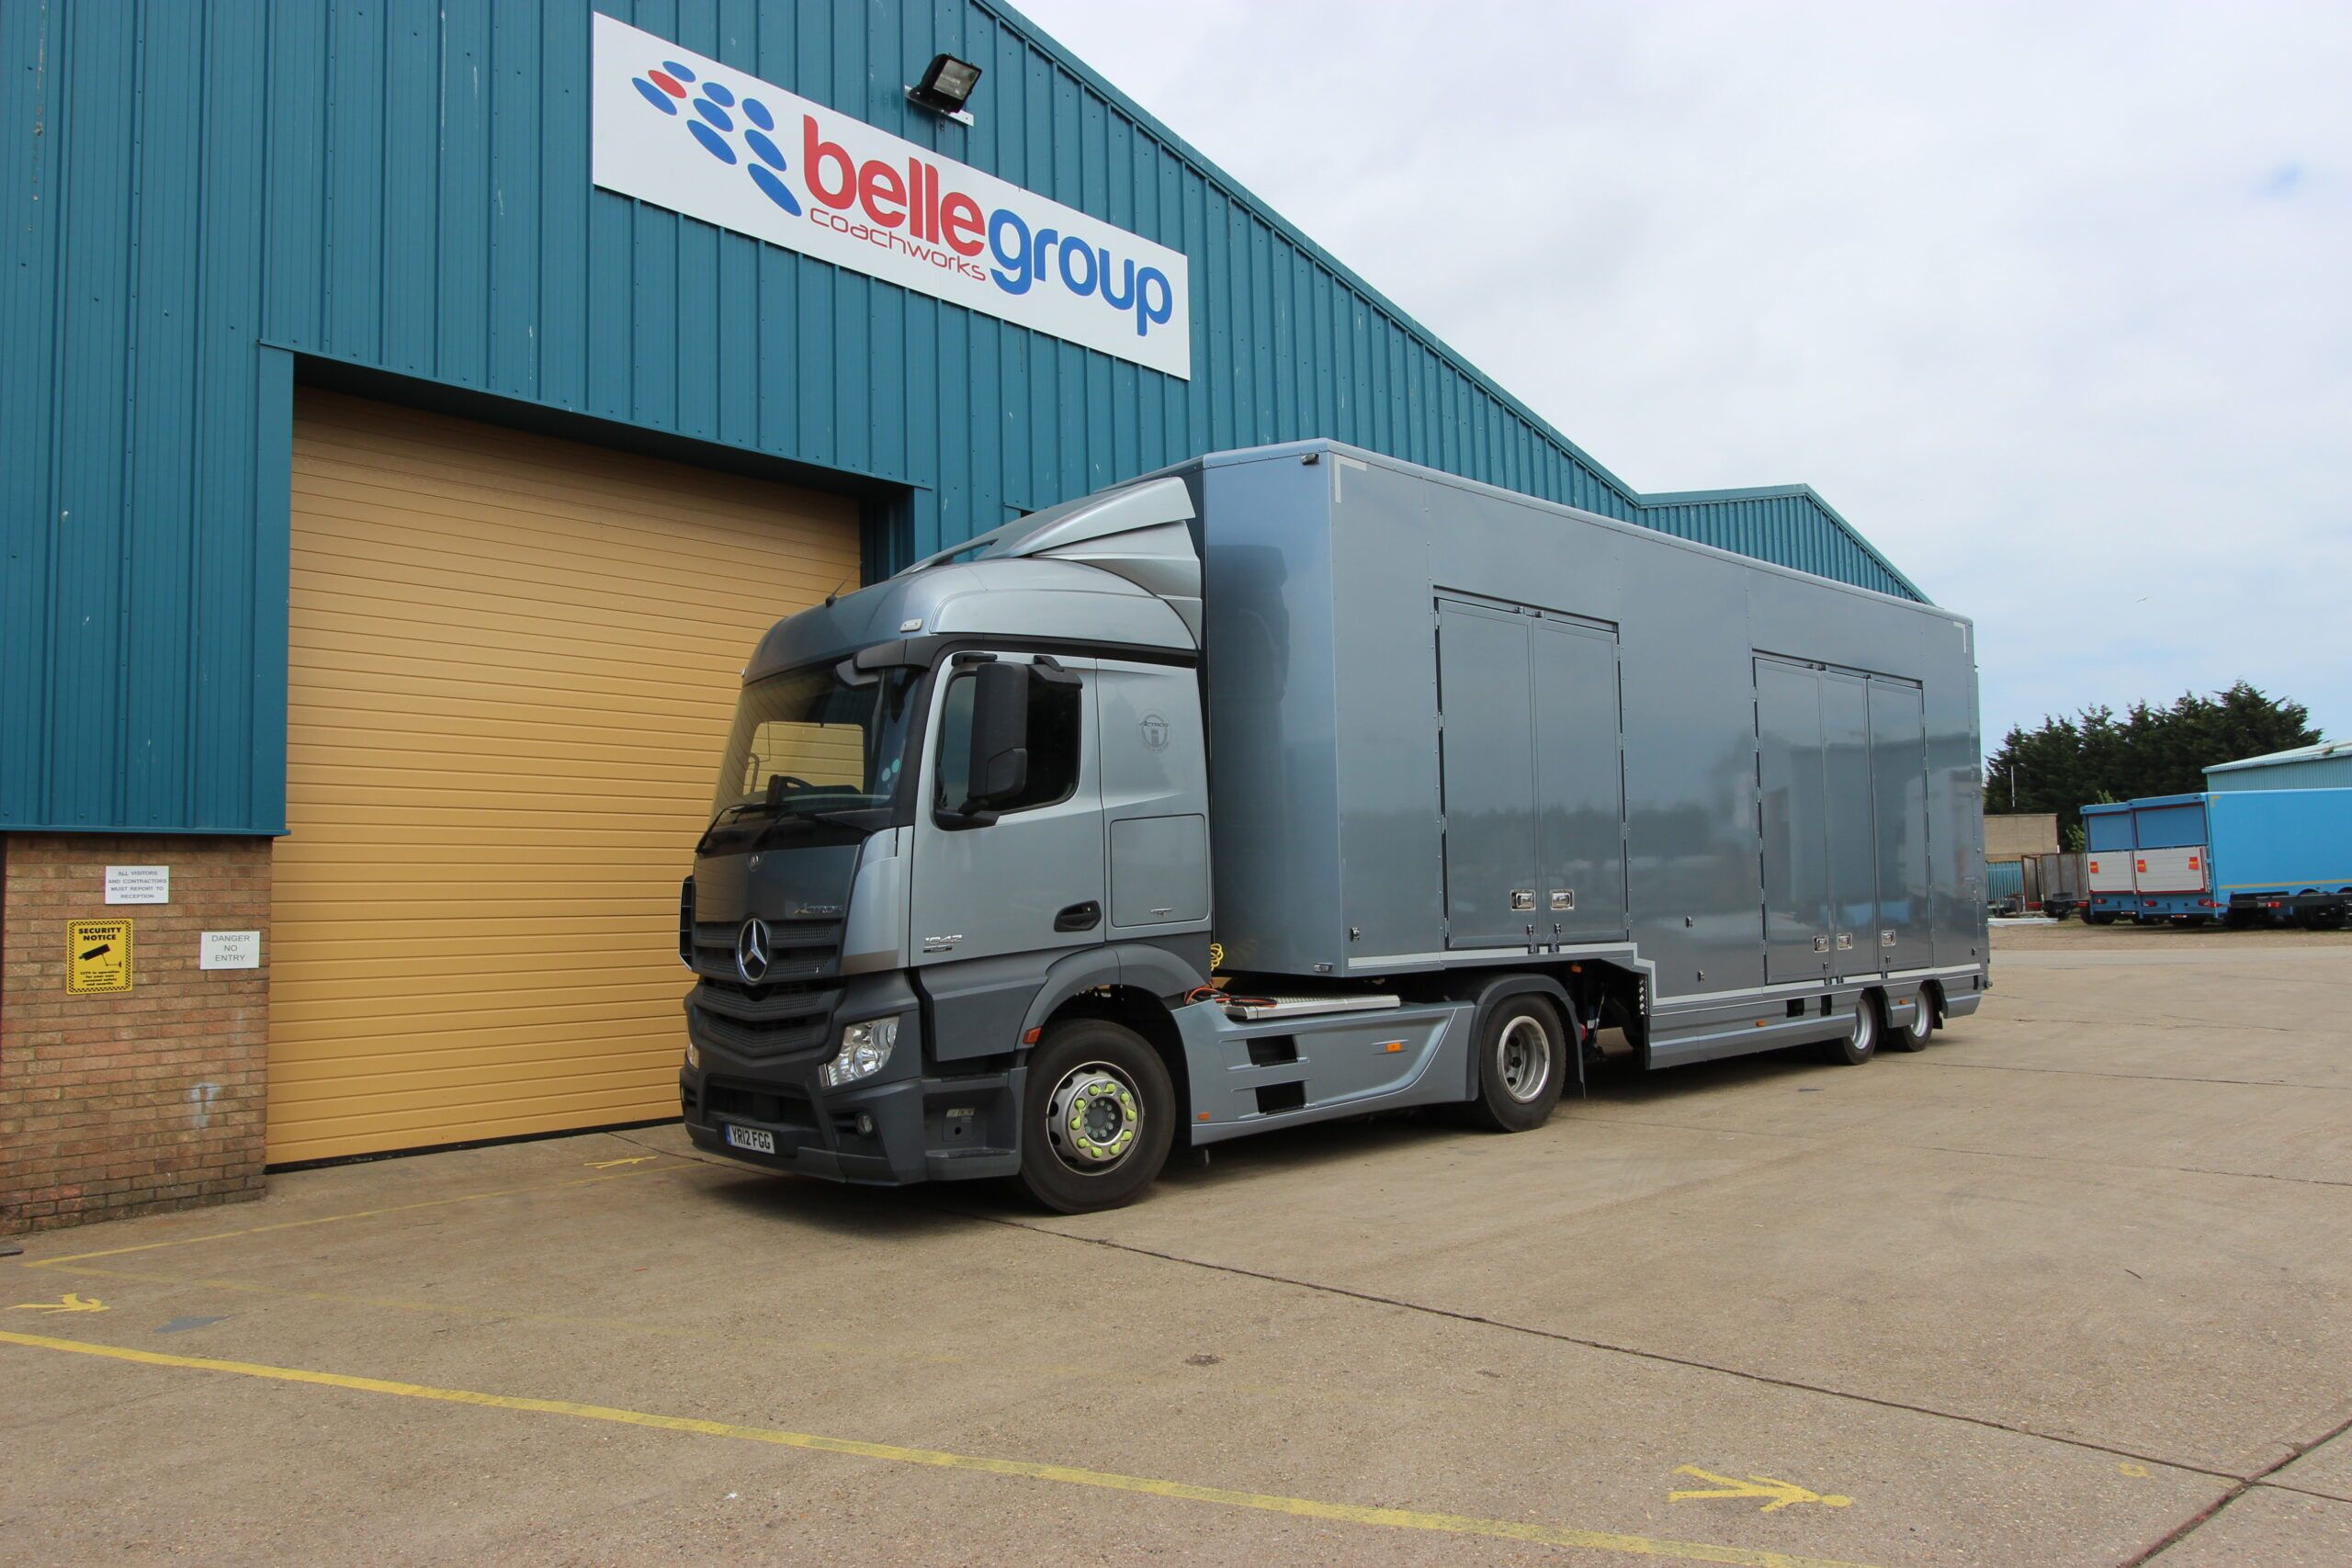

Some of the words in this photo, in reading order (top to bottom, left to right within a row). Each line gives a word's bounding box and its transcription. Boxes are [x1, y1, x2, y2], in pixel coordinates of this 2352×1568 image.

[810, 207, 987, 281] coachworks
[211, 934, 251, 942] DANGER
[731, 1126, 752, 1146] YR12
[752, 1131, 771, 1150] FGG
